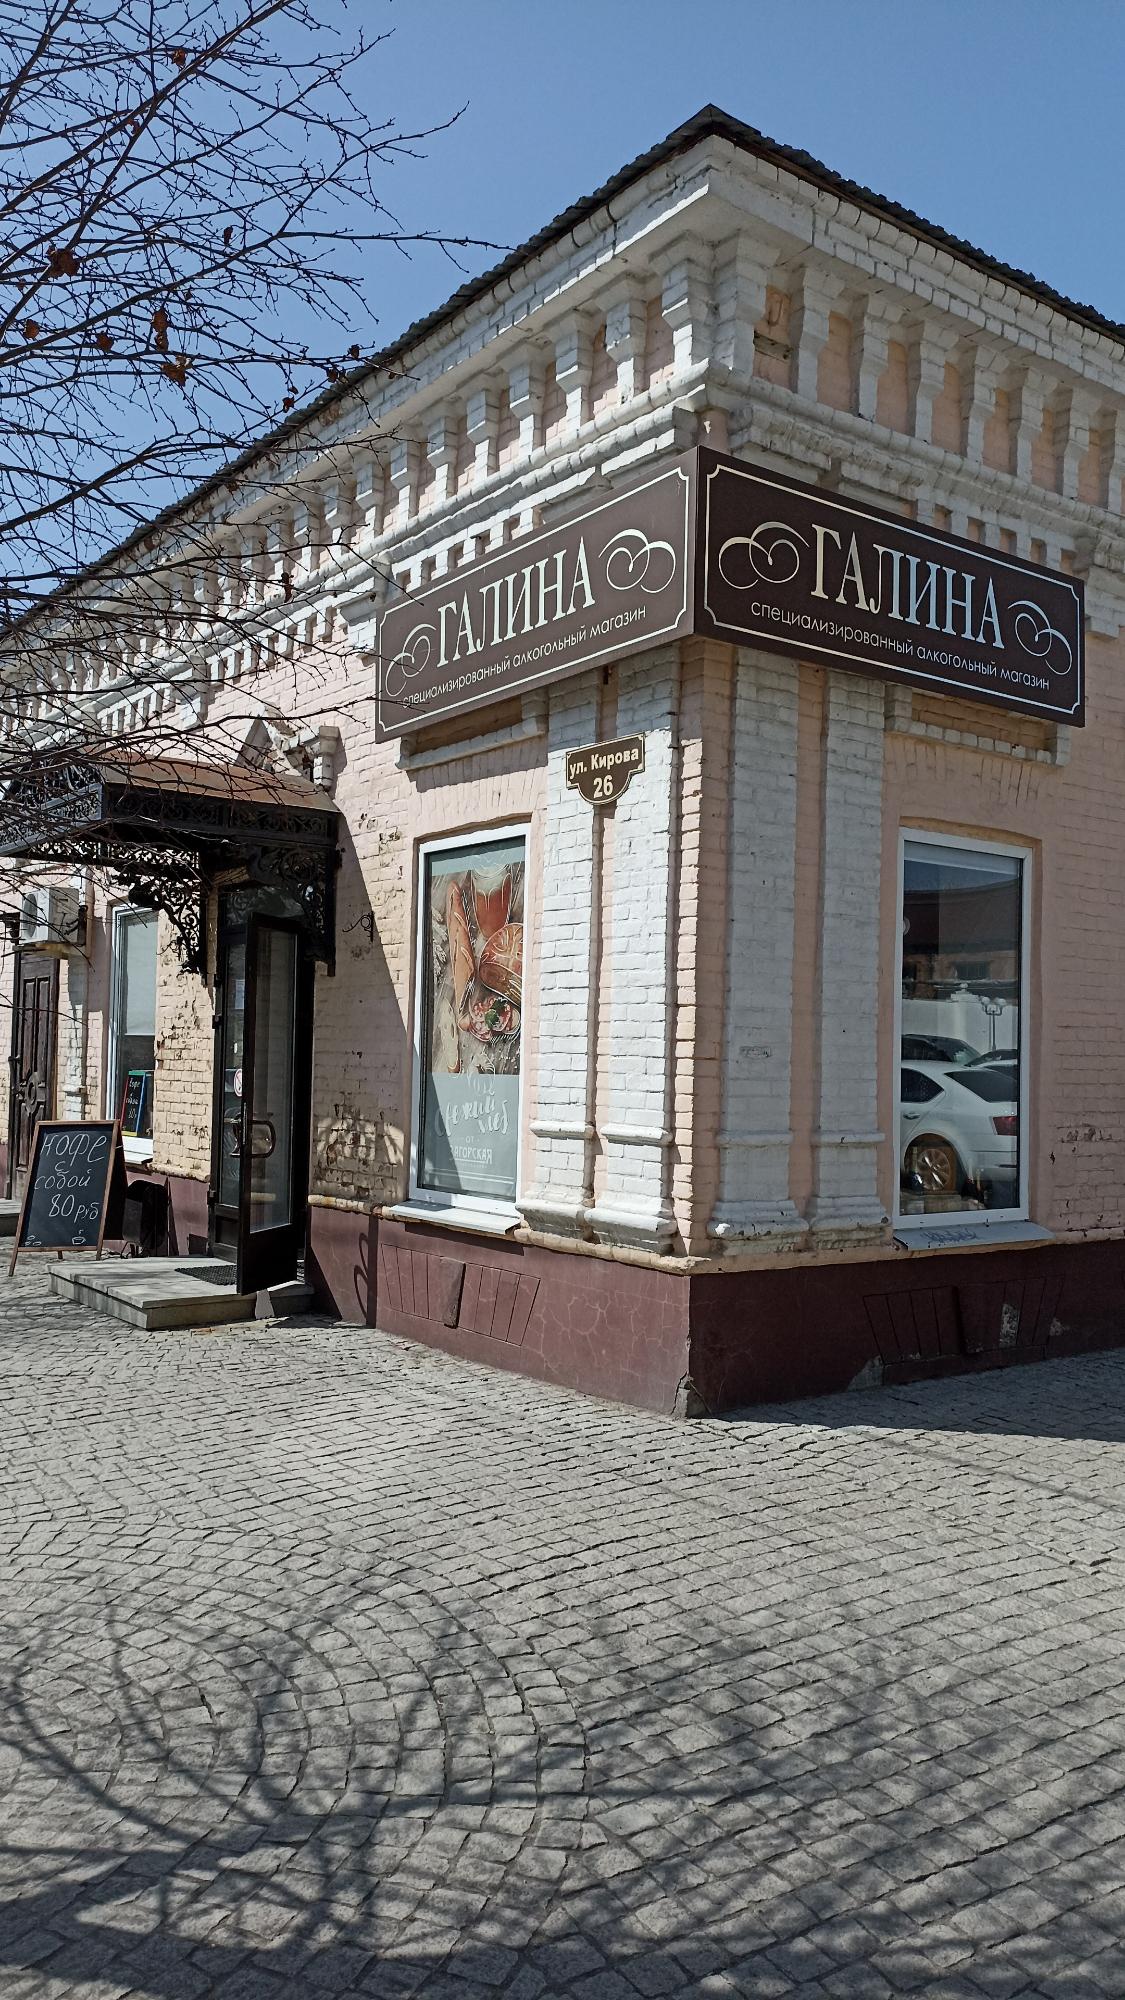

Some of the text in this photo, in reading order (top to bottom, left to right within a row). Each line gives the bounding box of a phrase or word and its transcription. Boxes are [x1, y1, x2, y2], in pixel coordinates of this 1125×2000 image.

[436, 536, 595, 668] ГАЛИНА
[811, 523, 1005, 649] ГАЛИНА
[402, 605, 647, 709] специализированный алкогольный магазин
[751, 600, 1050, 691] специализированный алкогольный магазин
[569, 748, 639, 780] ул. Кирова
[593, 774, 614, 799] 26
[34, 1169, 92, 1190] собой
[48, 1193, 100, 1224] 80 руб
